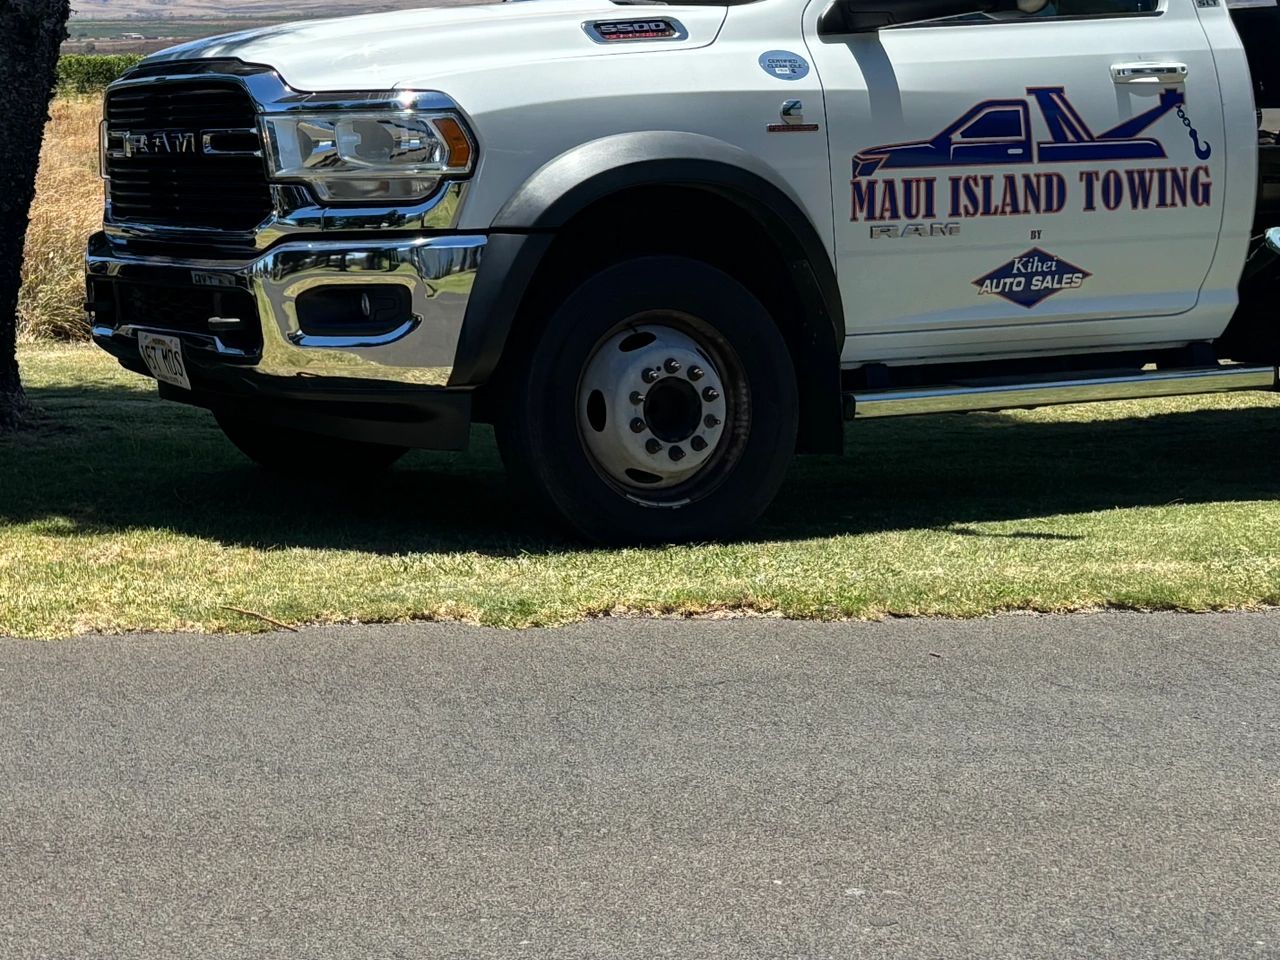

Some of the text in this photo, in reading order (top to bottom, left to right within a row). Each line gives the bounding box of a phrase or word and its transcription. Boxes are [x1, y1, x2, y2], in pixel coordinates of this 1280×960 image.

[600, 22, 666, 33] 5500
[126, 131, 195, 157] RAM
[849, 165, 1213, 222] MAUI ISLAND TOWING
[869, 222, 961, 240] RAM
[1030, 229, 1042, 240] BY
[1012, 255, 1059, 274] Kihei
[978, 272, 1083, 295] AUTO SALES
